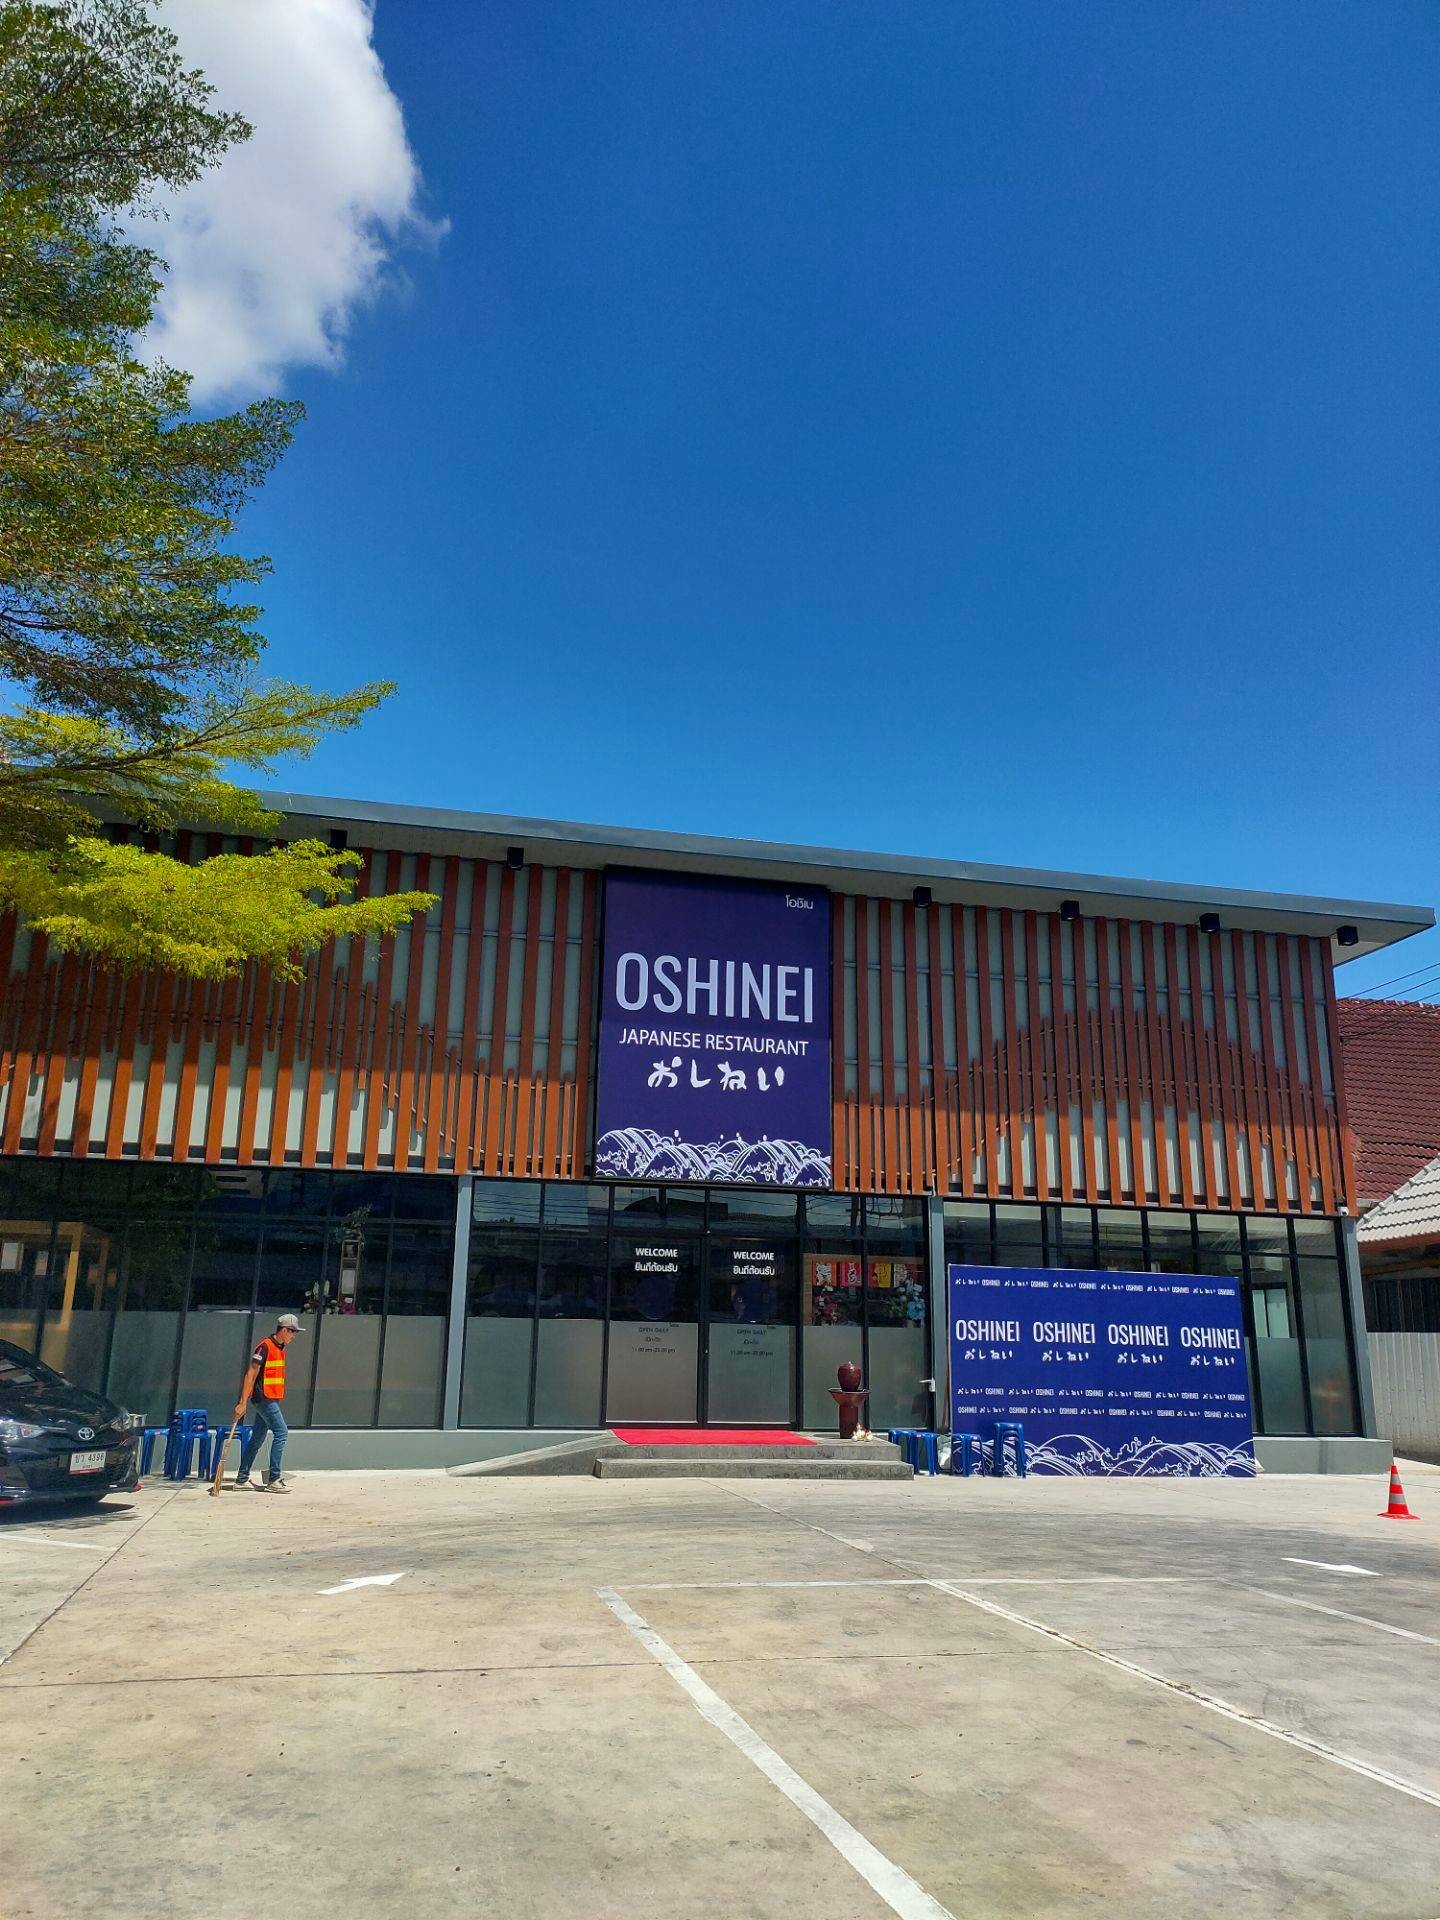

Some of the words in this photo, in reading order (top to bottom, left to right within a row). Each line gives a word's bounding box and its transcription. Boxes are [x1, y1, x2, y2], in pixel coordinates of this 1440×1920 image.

[615, 952, 813, 1024] OSHINEI
[619, 1028, 701, 1048] JAPANESE
[706, 1034, 809, 1056] RESTAURANT
[647, 1056, 785, 1091] おしねい
[635, 1247, 678, 1258] WELCOME
[732, 1251, 775, 1261] WELCOME
[956, 1320, 1020, 1341] OSHINEI
[1033, 1322, 1095, 1343] OSHINEI
[1108, 1324, 1168, 1346] OSHINEI
[1181, 1327, 1240, 1349] OSHINEI
